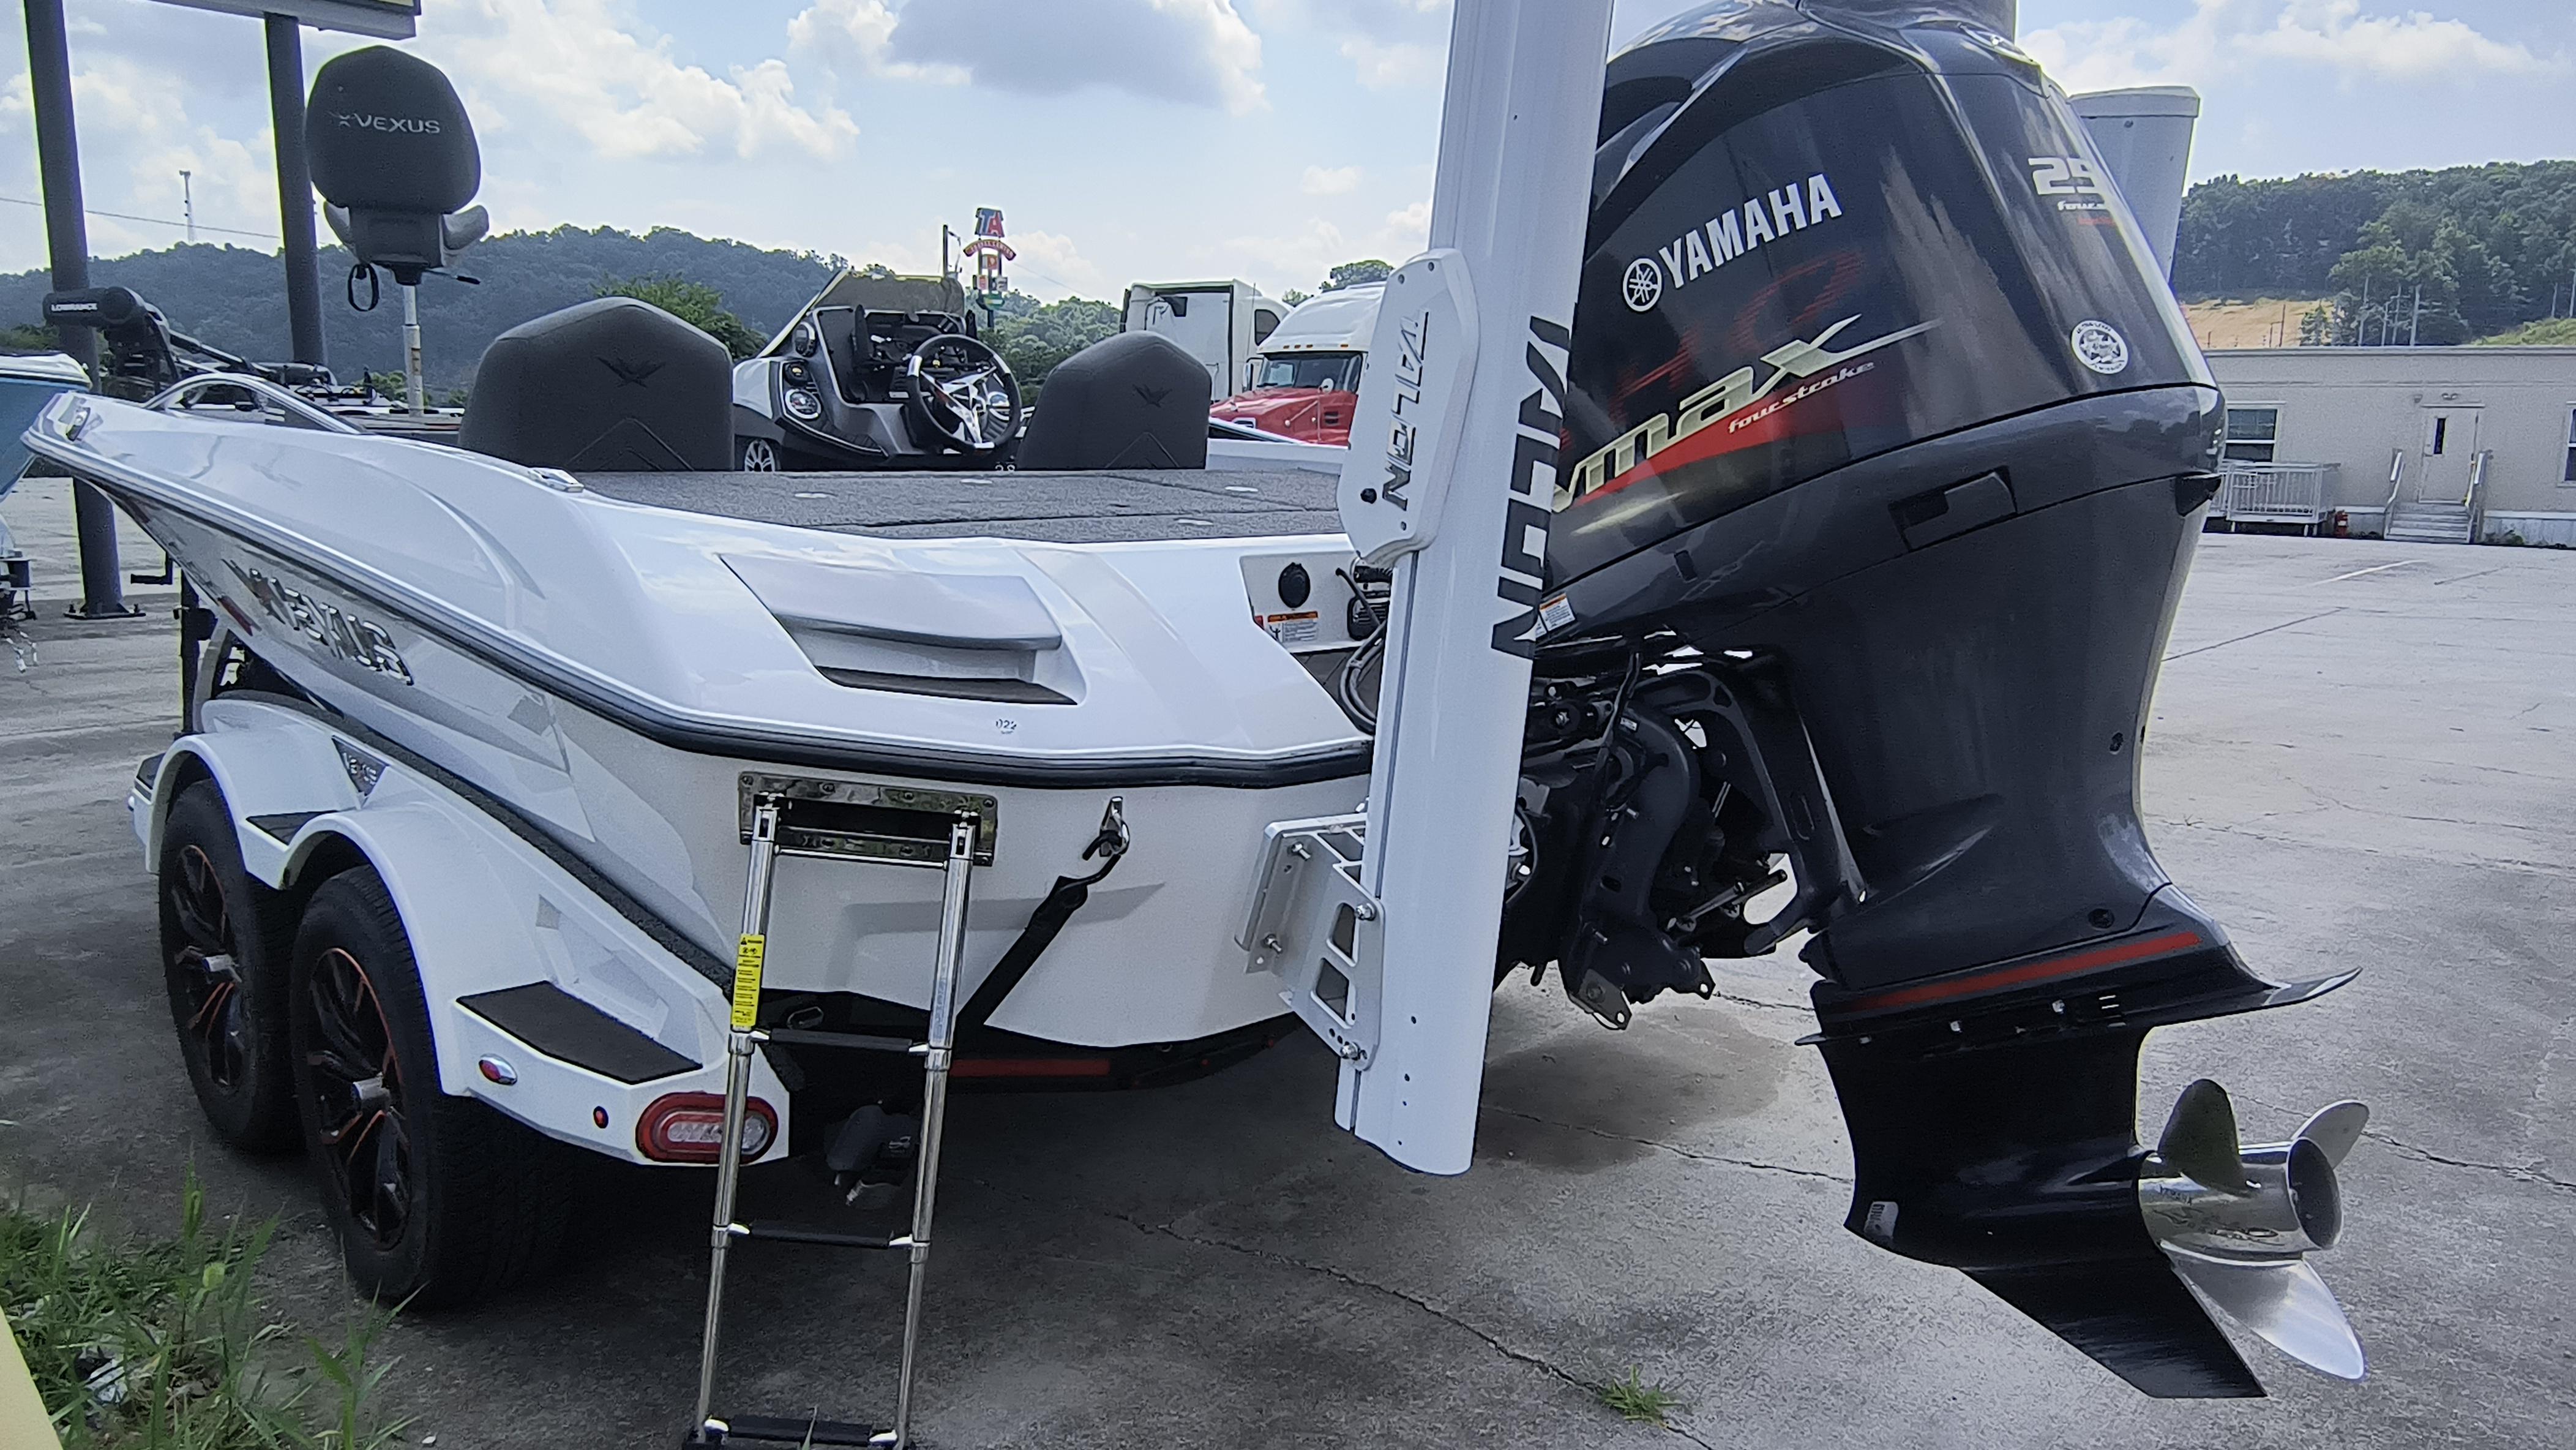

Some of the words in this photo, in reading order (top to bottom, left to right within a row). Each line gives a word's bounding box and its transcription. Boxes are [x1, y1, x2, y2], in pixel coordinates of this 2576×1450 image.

[353, 113, 440, 133] VEXUS
[979, 209, 1004, 237] TA
[1658, 173, 1842, 289] YAMAHA
[1382, 309, 1429, 511] TALON
[1491, 315, 1570, 660] TALON
